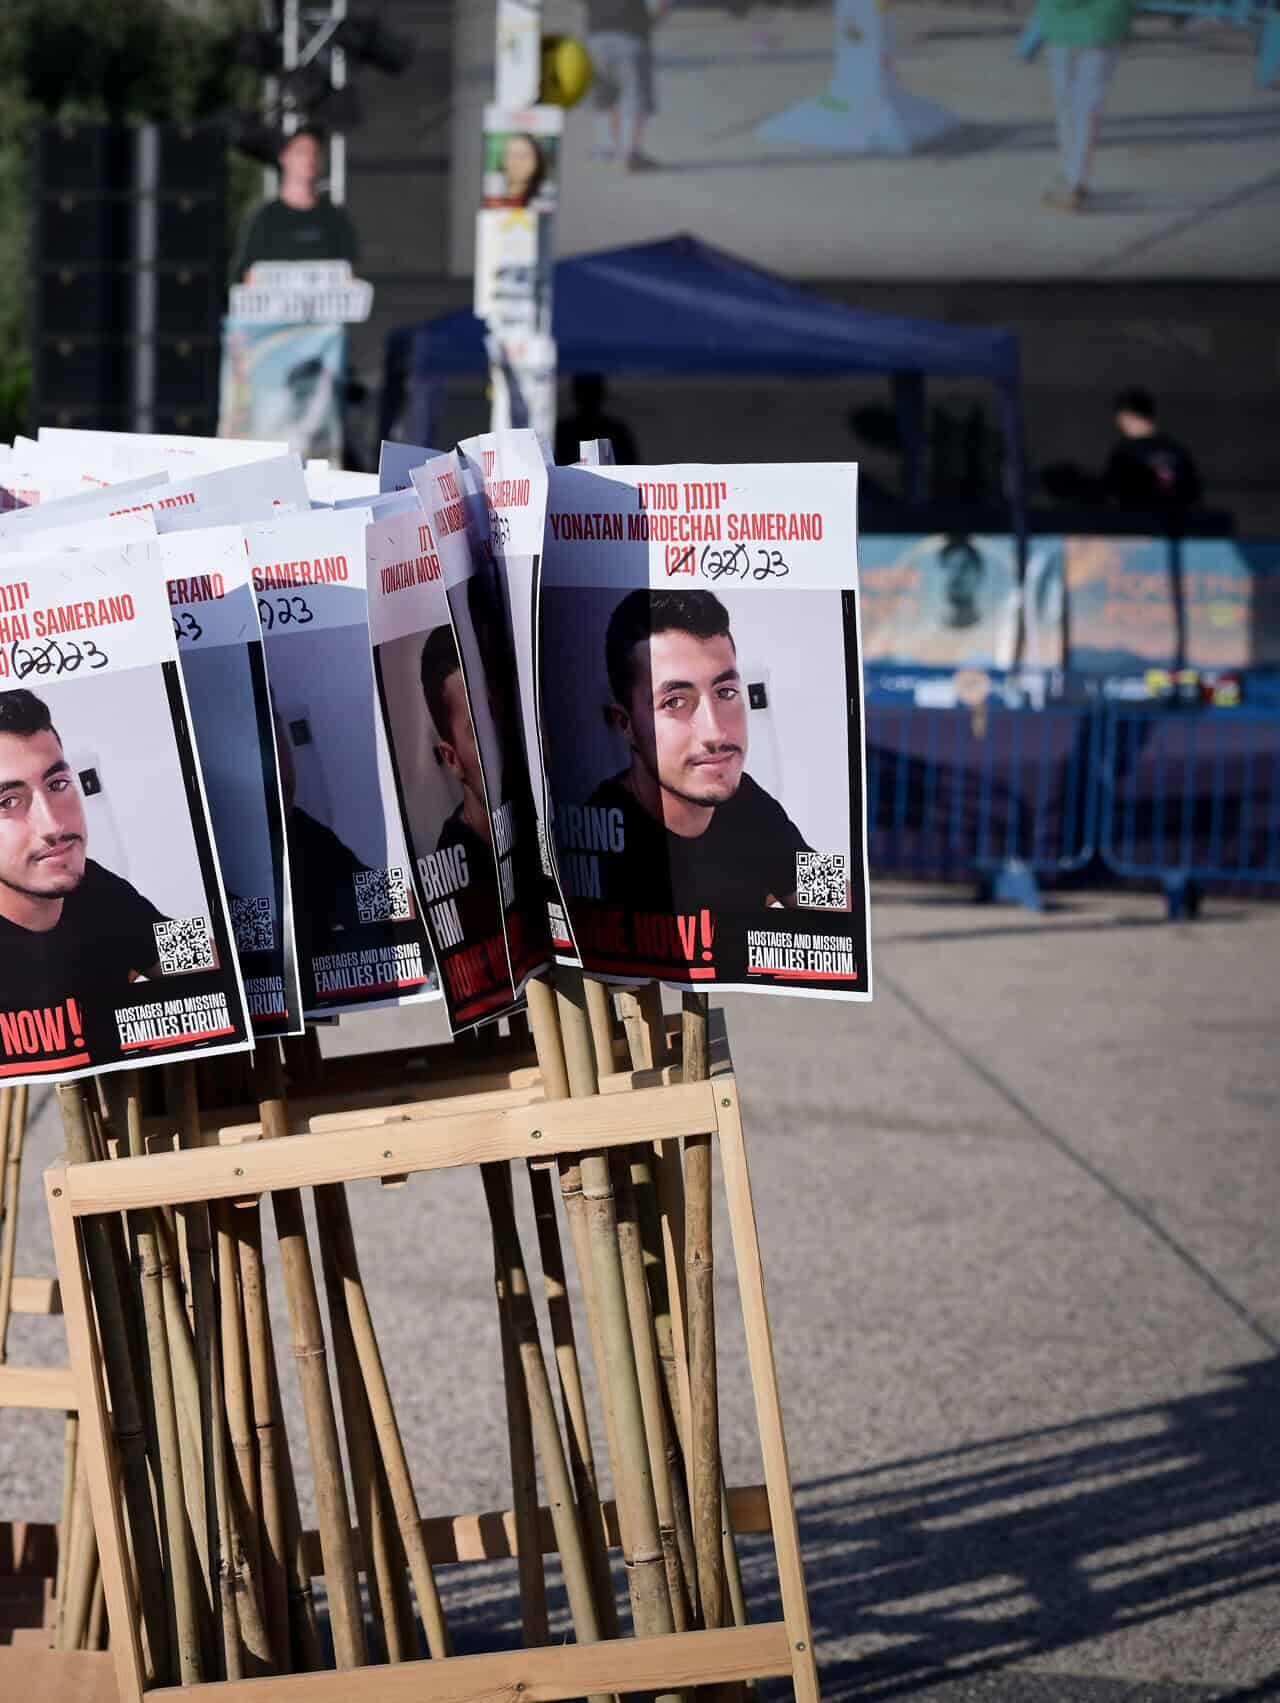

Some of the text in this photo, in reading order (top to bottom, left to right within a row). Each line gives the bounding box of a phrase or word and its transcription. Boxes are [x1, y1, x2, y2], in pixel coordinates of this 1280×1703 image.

[637, 482, 727, 513] יונתן סמרנו
[550, 512, 824, 541] YONATAN MORDECHAI SAMERANO
[252, 556, 349, 593] SAMERANO
[380, 559, 415, 596] YONATAN
[753, 549, 790, 580] 23
[34, 593, 137, 637] SAMERANO
[417, 843, 470, 903] BRING
[429, 898, 465, 951] HIM
[312, 942, 421, 972] HOSTAGES AND MISSING
[747, 931, 853, 953] HOSTAGES AND MISSING
[314, 957, 424, 993] FAMILIES FORUM
[748, 947, 854, 975] FAMILIES FORUM
[115, 991, 227, 1024] HOSTAGES AND MISSING
[119, 1007, 232, 1046] FAMILIES FORUM
